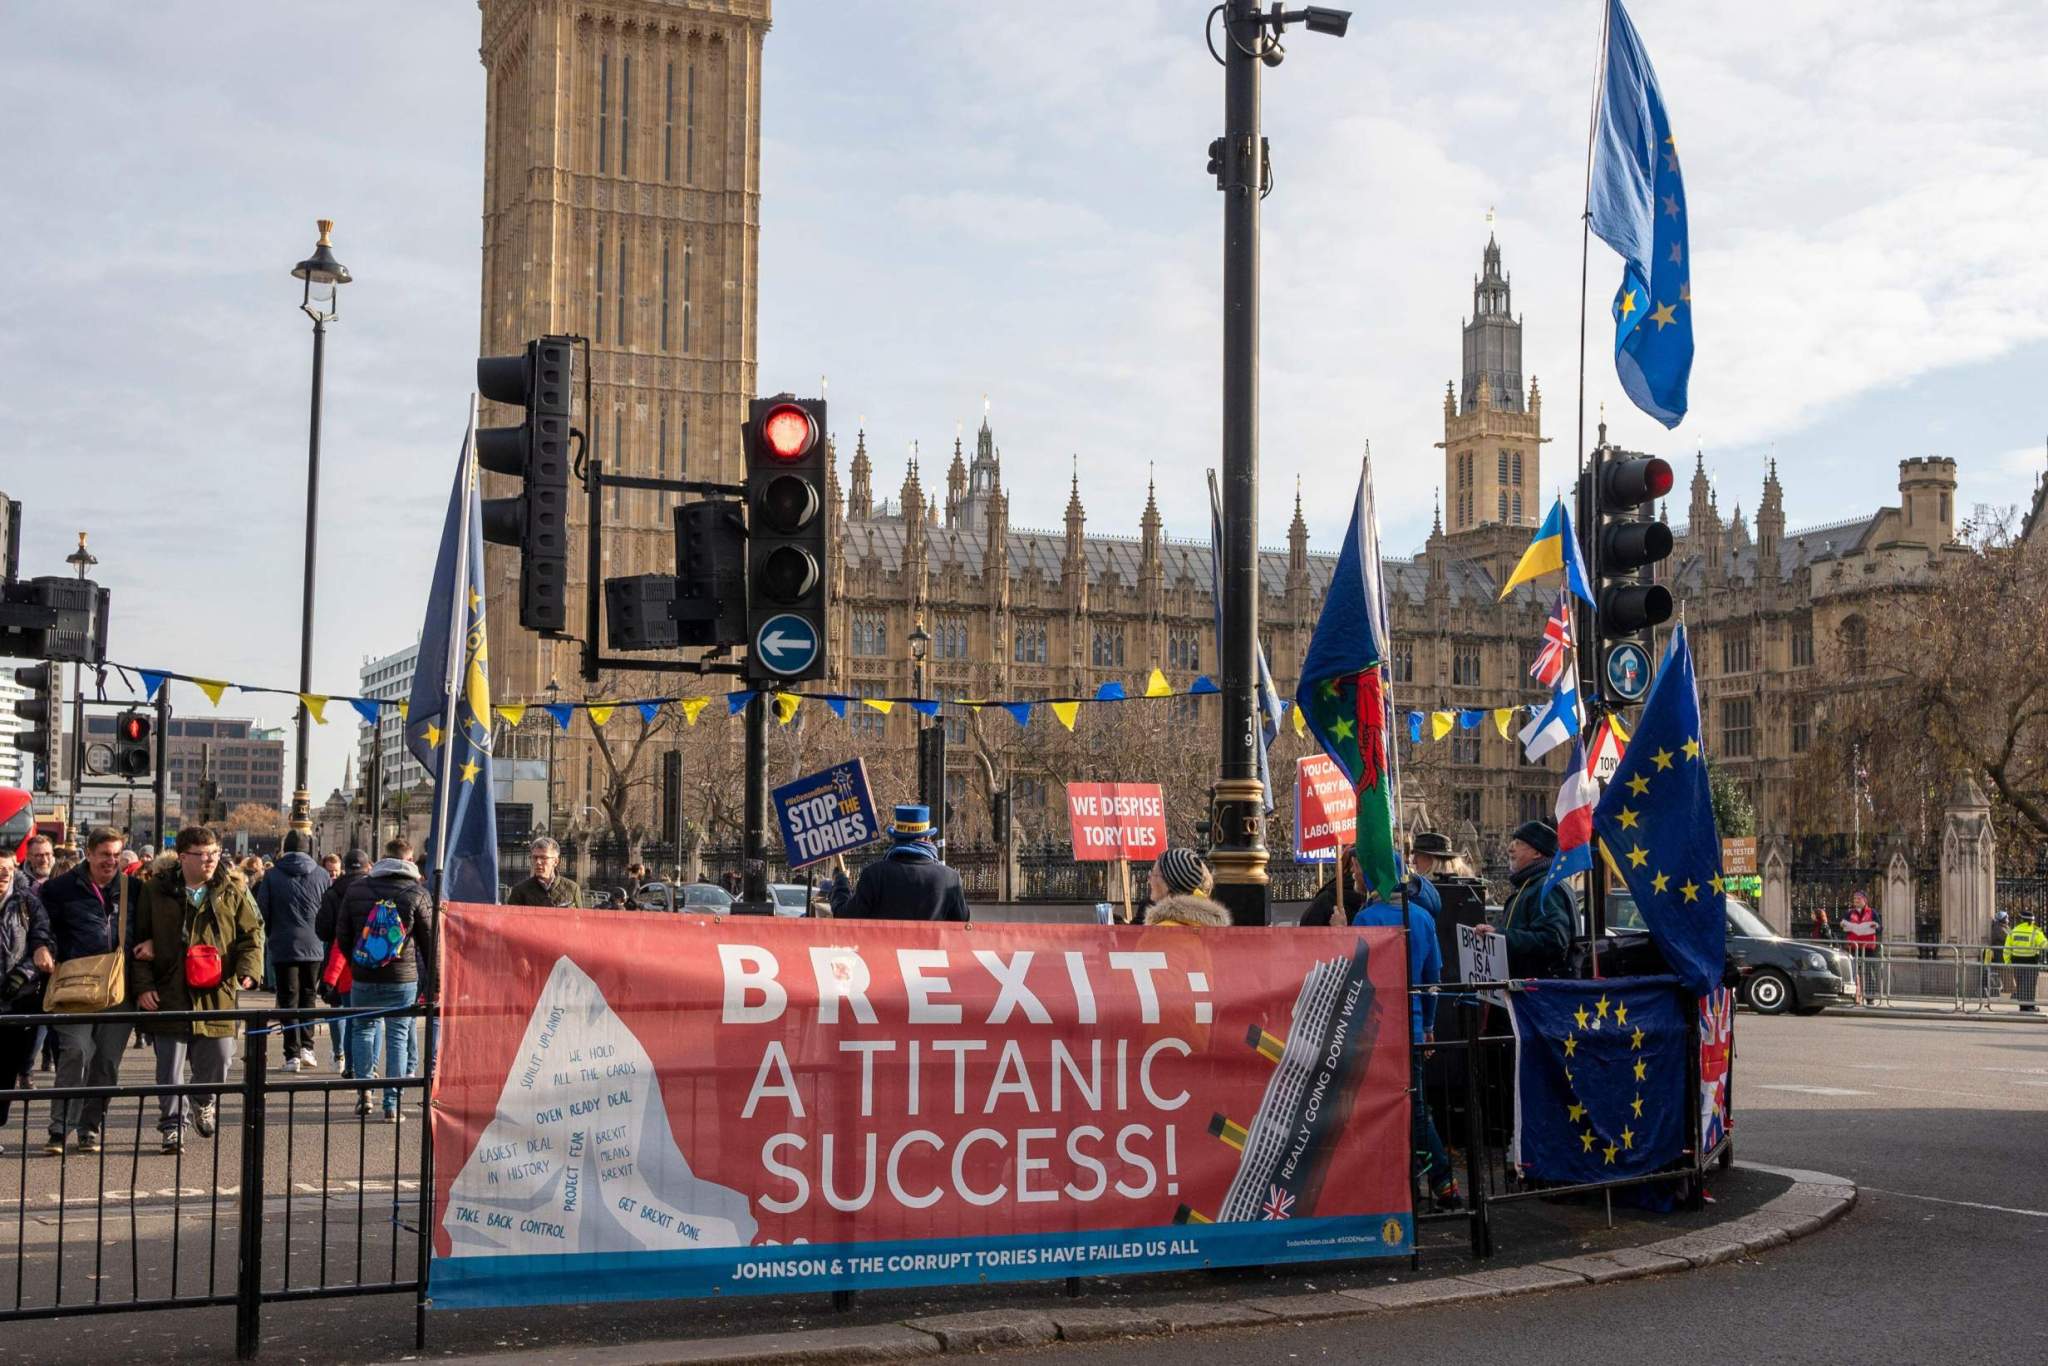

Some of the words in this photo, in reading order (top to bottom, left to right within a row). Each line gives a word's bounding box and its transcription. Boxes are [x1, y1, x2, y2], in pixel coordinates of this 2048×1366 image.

[1302, 764, 1322, 777] YOU
[1600, 756, 1618, 770] TORY
[1306, 785, 1314, 798] A
[1314, 780, 1337, 796] TORY
[1339, 779, 1354, 791] BR
[787, 793, 837, 833] STOP
[838, 796, 861, 815] THE
[1072, 796, 1098, 816] WE
[1102, 796, 1161, 817] DESPISE
[1323, 801, 1345, 814] WITH
[1346, 798, 1353, 809] A
[794, 813, 868, 859] TORIES
[1083, 826, 1122, 846] TORY
[1127, 826, 1157, 846] LIES
[1304, 820, 1341, 839] LABOUR
[1341, 817, 1357, 832] BRE
[1461, 927, 1496, 956] BREXIT
[1473, 952, 1483, 973] IS
[1485, 955, 1491, 976] A
[717, 943, 1213, 1025] BREXIT:
[521, 1053, 544, 1089] SUNLIT
[537, 1005, 565, 1050] UPLANDS
[568, 1050, 582, 1063] WE
[589, 1044, 616, 1060] HOLD
[553, 1072, 571, 1086] ALL
[580, 1067, 600, 1083] THE
[606, 1061, 638, 1078] CARDS
[741, 1040, 807, 1119] A
[839, 1037, 1193, 1117] TITANIC
[1280, 1123, 1312, 1180] REALLY
[1305, 1071, 1331, 1122] GOING
[1326, 1019, 1349, 1070] DOWN
[1342, 978, 1364, 1017] WELL
[536, 1111, 563, 1125] OVEN
[569, 1098, 602, 1116] READY
[607, 1090, 633, 1109] DEAL
[569, 1131, 584, 1158] FEAR
[595, 1125, 626, 1145] BREXIT
[479, 1142, 518, 1163] EASIEST
[526, 1137, 553, 1154] DEAL
[600, 1145, 630, 1162] MEANS
[488, 1171, 498, 1184] IN
[506, 1159, 550, 1180] HISTORY
[601, 1163, 633, 1182] BREXIT
[758, 1123, 1179, 1214] SUCCESS!
[563, 1165, 579, 1212] PROJECT
[456, 1207, 480, 1223] TAKE
[487, 1213, 513, 1229] BACK
[520, 1219, 566, 1239] CONTROL
[618, 1196, 637, 1213] GET
[640, 1205, 674, 1228] BREXIT
[677, 1221, 701, 1241] DONE
[732, 1259, 827, 1280] JOHNSON
[830, 1258, 844, 1275] &
[848, 1257, 884, 1273] THE
[887, 1252, 973, 1272] CORRUPT
[975, 1249, 1037, 1267] TORIES
[1040, 1246, 1086, 1264] HAVE
[1089, 1242, 1144, 1260] FAILED
[1146, 1241, 1167, 1256] US
[1170, 1239, 1199, 1255] ALL
